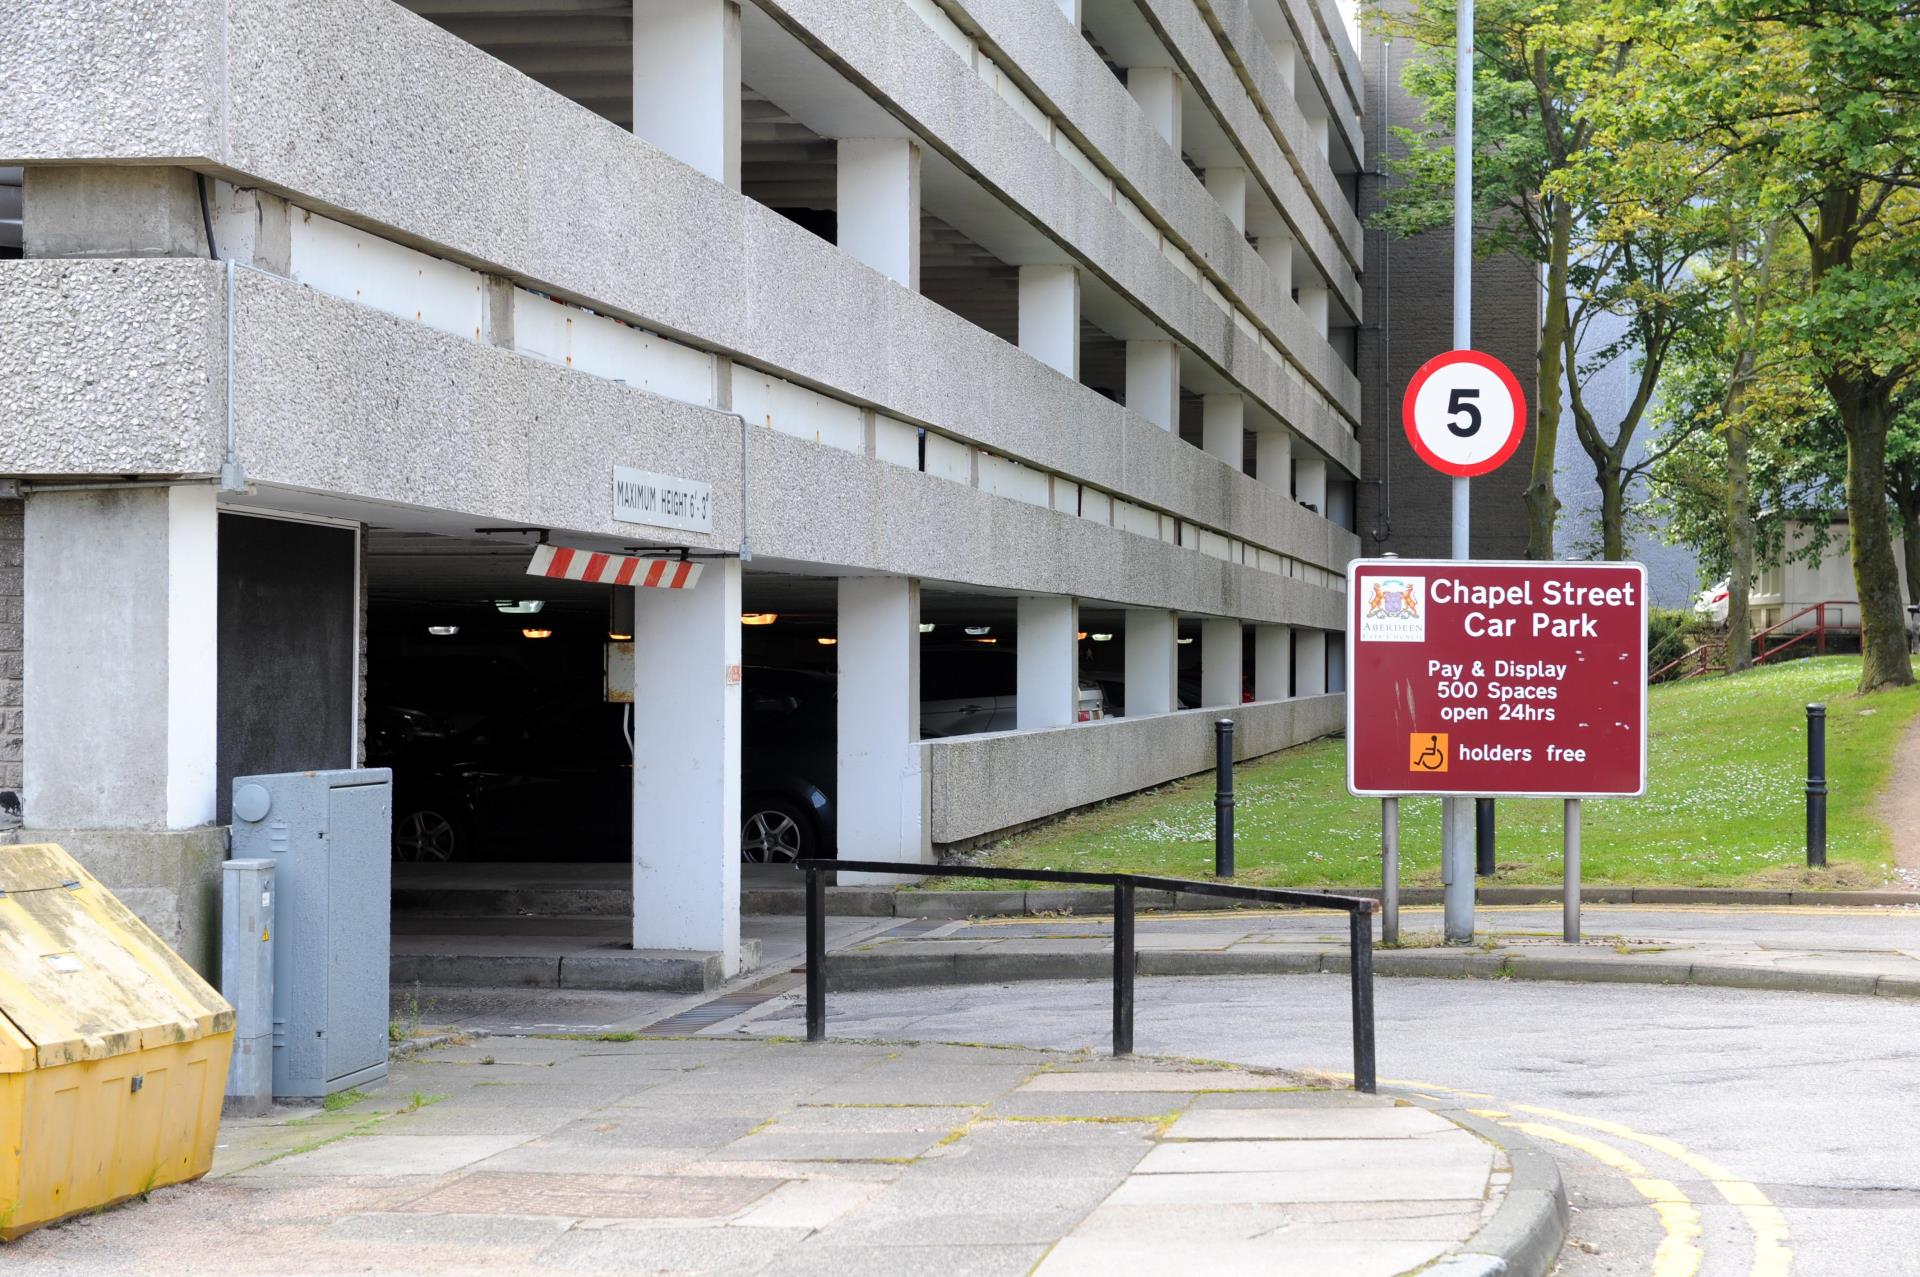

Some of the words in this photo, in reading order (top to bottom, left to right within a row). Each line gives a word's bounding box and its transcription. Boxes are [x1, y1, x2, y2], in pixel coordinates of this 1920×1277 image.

[1447, 388, 1482, 438] 5
[617, 480, 657, 513] MAXIMUM
[661, 488, 688, 518] HEIGHT
[1430, 578, 1533, 609] Chapel
[1542, 580, 1635, 607] Street
[1363, 622, 1423, 632] ABERDEEN
[1464, 611, 1517, 638] Car
[1532, 612, 1598, 638] Park
[1428, 659, 1463, 681] Pay
[1471, 660, 1485, 678] &
[1494, 660, 1567, 681] Display
[1437, 681, 1478, 699] 500
[1487, 681, 1558, 702] Spaces
[1440, 706, 1489, 724] open
[1498, 703, 1556, 721] 24hrs
[1459, 743, 1532, 762] holders
[1546, 744, 1587, 763] free
